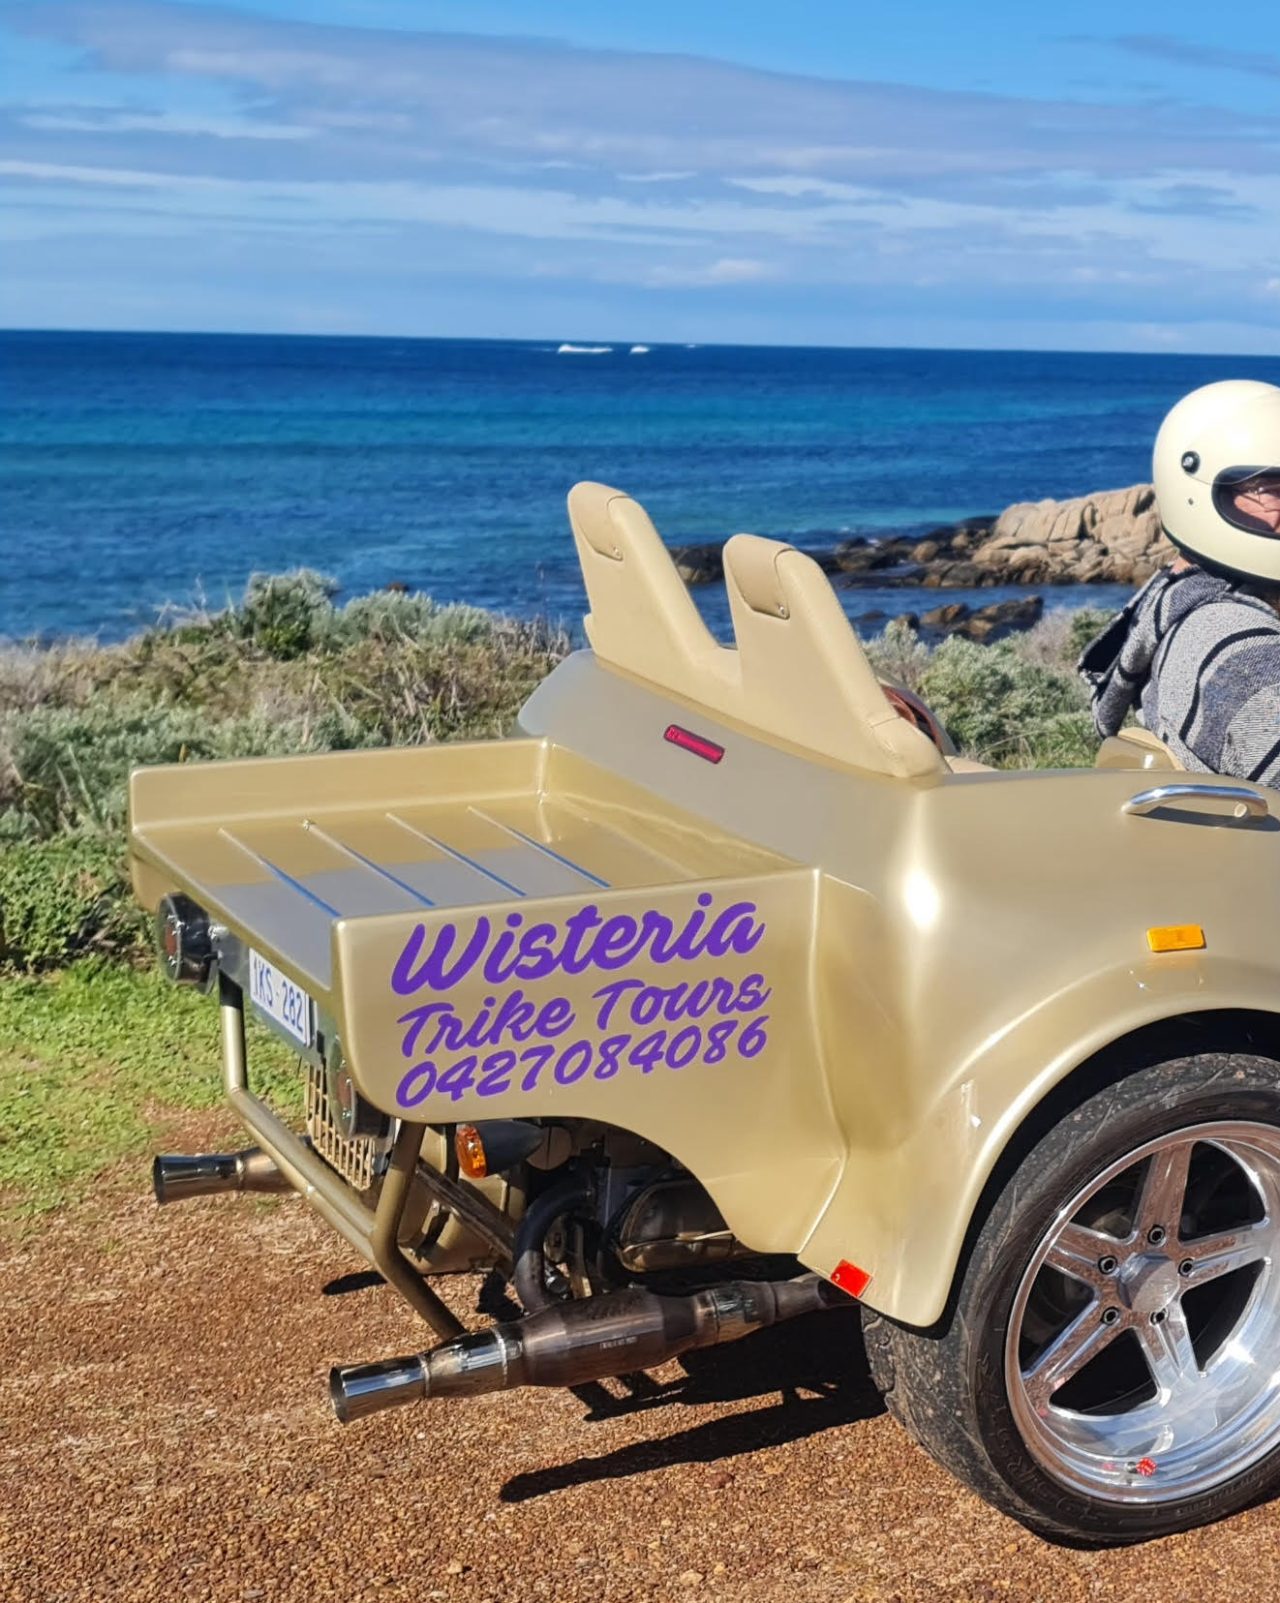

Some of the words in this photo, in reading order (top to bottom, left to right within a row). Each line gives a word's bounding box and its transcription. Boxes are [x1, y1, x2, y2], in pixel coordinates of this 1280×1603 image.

[391, 892, 765, 995] Wisteria
[395, 1015, 770, 1108] 0427084086
[397, 990, 576, 1057] Trike
[592, 974, 771, 1030] Tours
